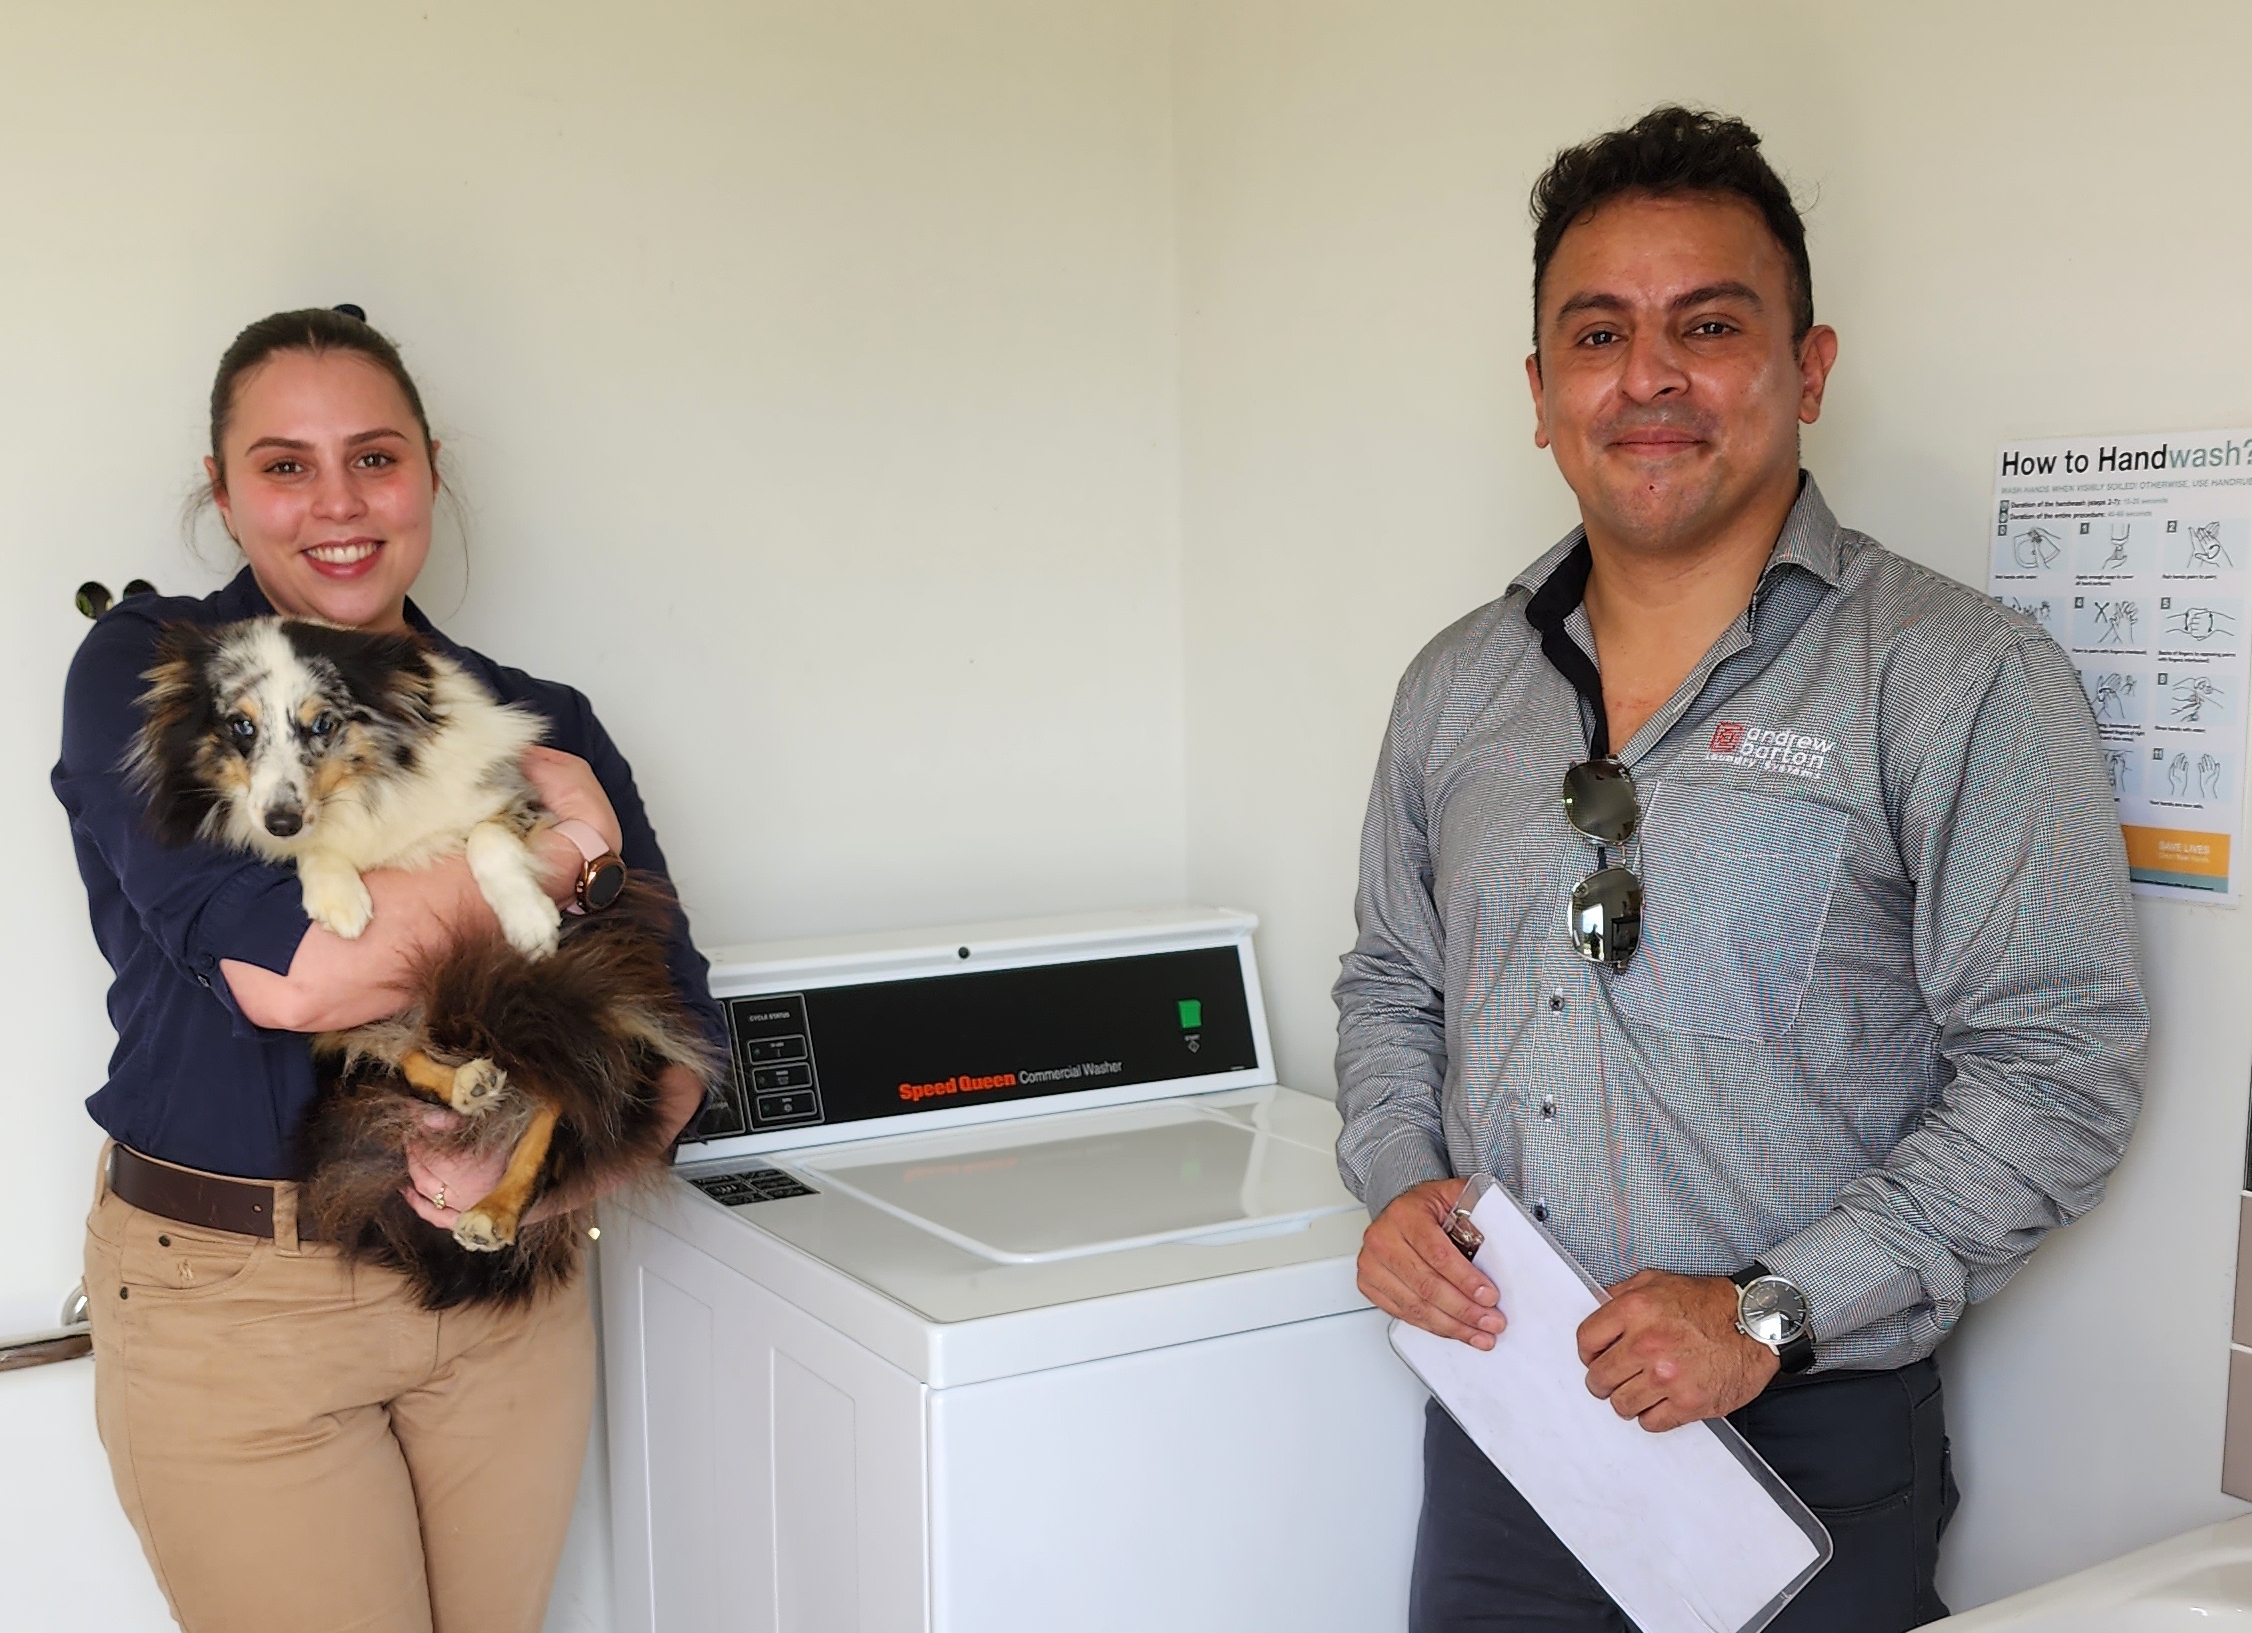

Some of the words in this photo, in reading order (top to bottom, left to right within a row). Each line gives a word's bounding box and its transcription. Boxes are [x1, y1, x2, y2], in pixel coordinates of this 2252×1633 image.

[2001, 451, 2057, 477] How
[2065, 449, 2089, 474] to
[2192, 479, 2209, 488] USE
[1746, 727, 1835, 753] andrew
[1740, 738, 1825, 770] barton
[2184, 844, 2211, 855] LIVES
[749, 1013, 768, 1022] CYCLE
[769, 1011, 791, 1020] STATUS
[899, 1077, 957, 1101] Speed
[959, 1072, 1016, 1092] Queen
[1018, 1064, 1082, 1085] Commercial
[1082, 1060, 1123, 1077] Washer
